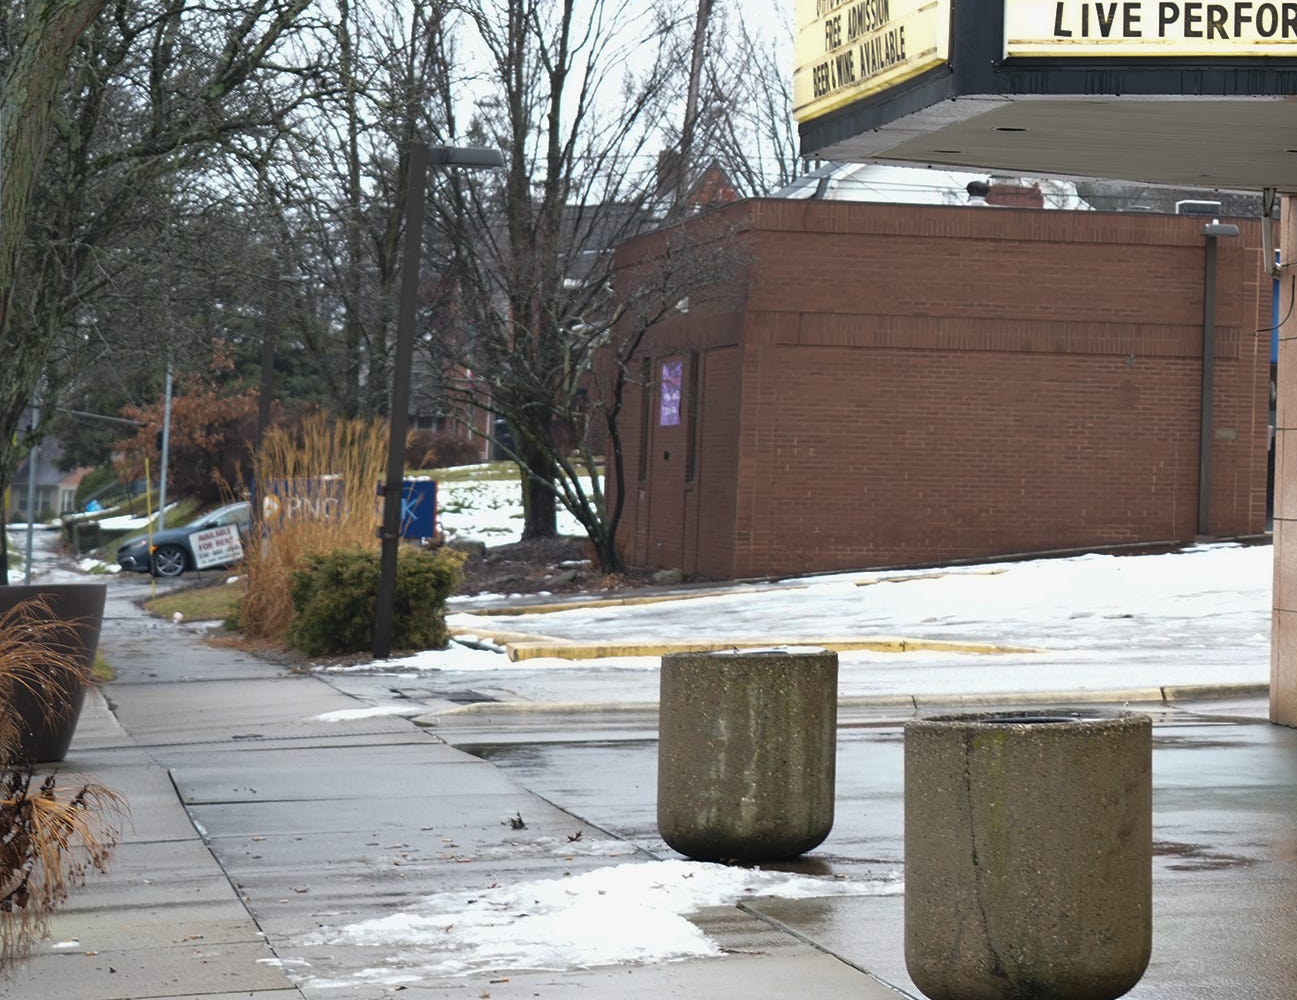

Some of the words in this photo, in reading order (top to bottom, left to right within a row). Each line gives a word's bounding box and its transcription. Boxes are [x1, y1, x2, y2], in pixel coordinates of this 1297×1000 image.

[825, 13, 842, 52] FREE
[1053, 2, 1142, 38] LIVE
[812, 61, 831, 98] BEER
[835, 49, 856, 88] WINE
[859, 25, 906, 78] AVAILABLE
[286, 497, 339, 520] PNC
